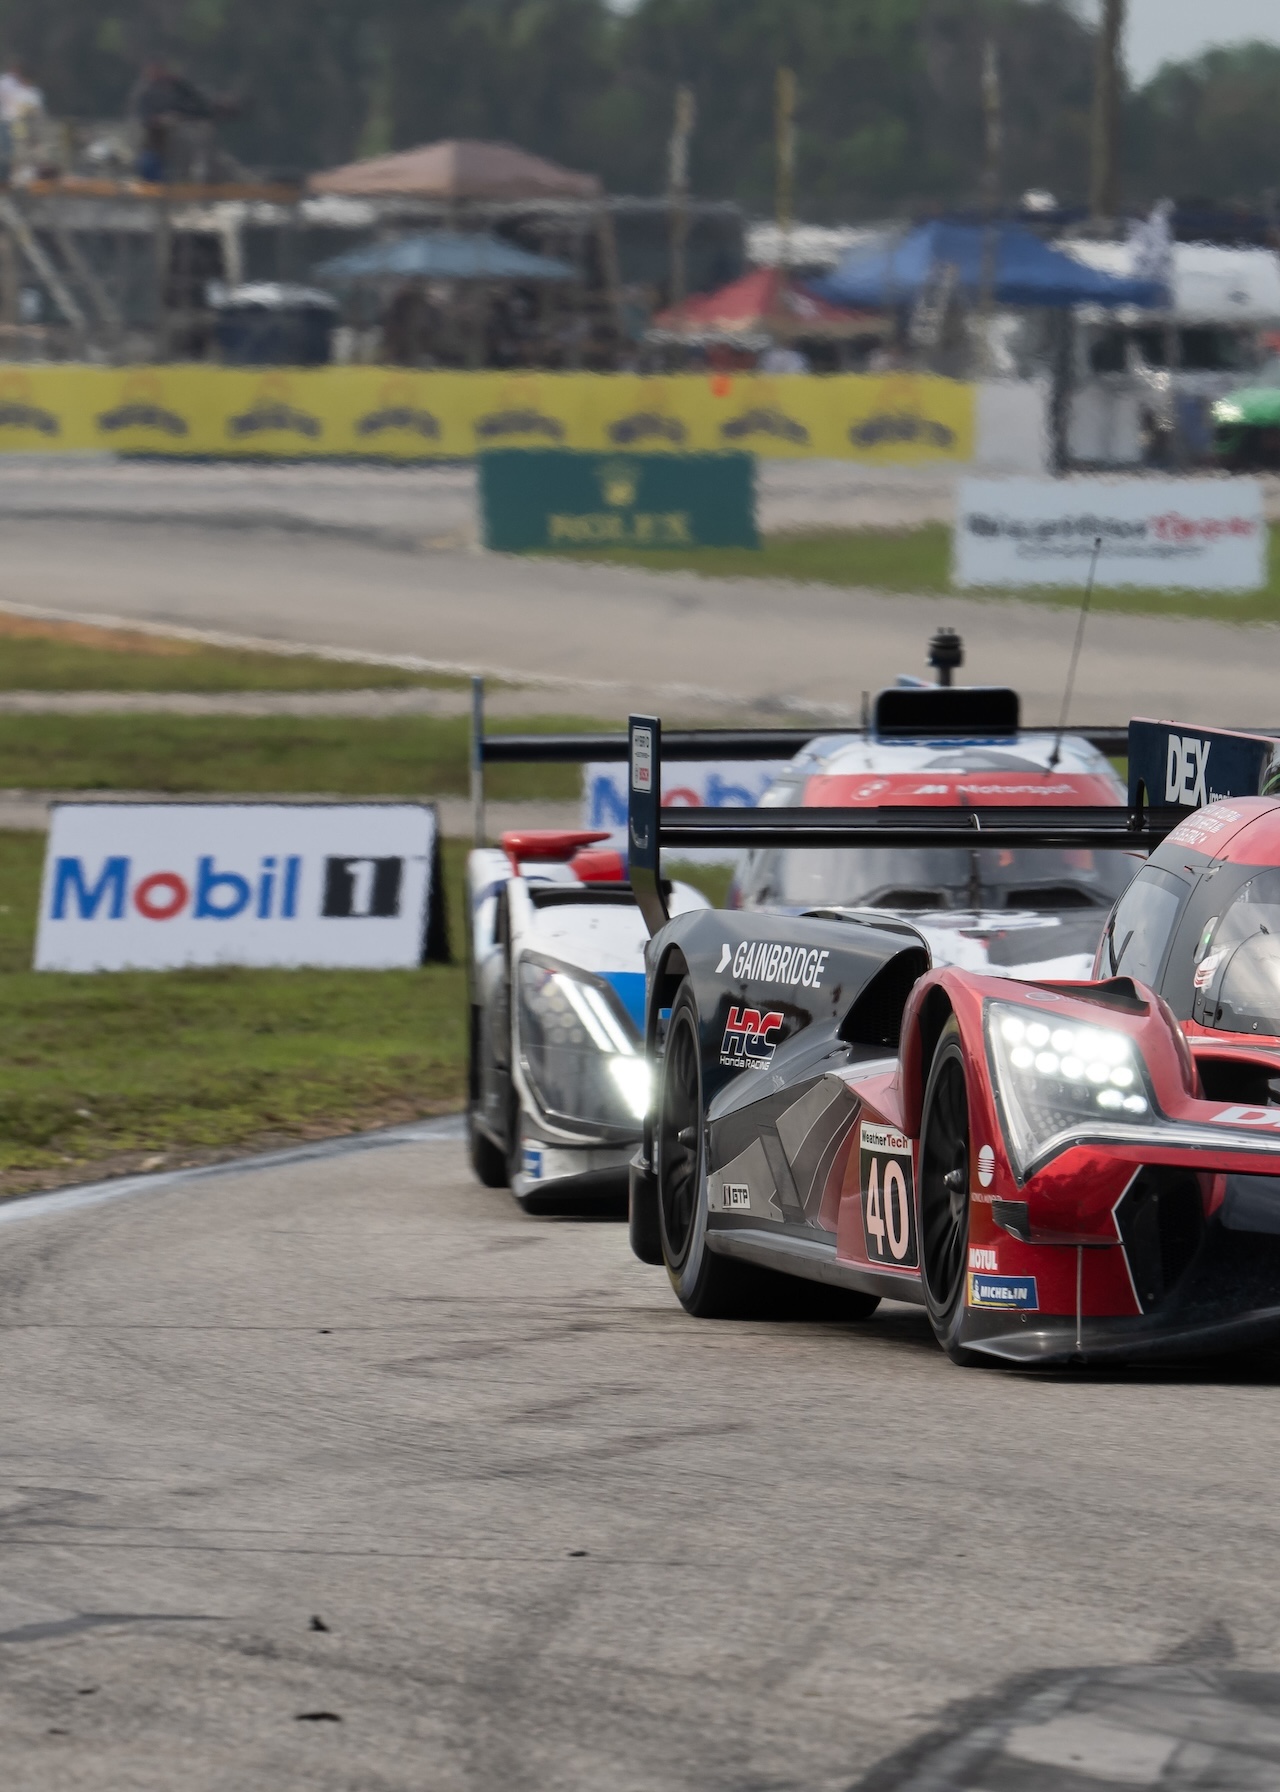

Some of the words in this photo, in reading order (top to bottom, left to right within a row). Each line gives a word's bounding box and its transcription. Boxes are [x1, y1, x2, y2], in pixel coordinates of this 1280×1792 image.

[1165, 733, 1211, 809] DEX
[49, 854, 302, 921] Mobil
[732, 940, 830, 989] GAINBRIDGE
[720, 1006, 785, 1061] HRC
[719, 1055, 744, 1068] Honda
[745, 1058, 771, 1071] RACING
[861, 1129, 909, 1149] WeatherTech
[732, 1188, 749, 1204] GTP
[866, 1157, 910, 1260] 40
[968, 1247, 999, 1271] MOTUL
[980, 1285, 1029, 1300] MICHELIN
